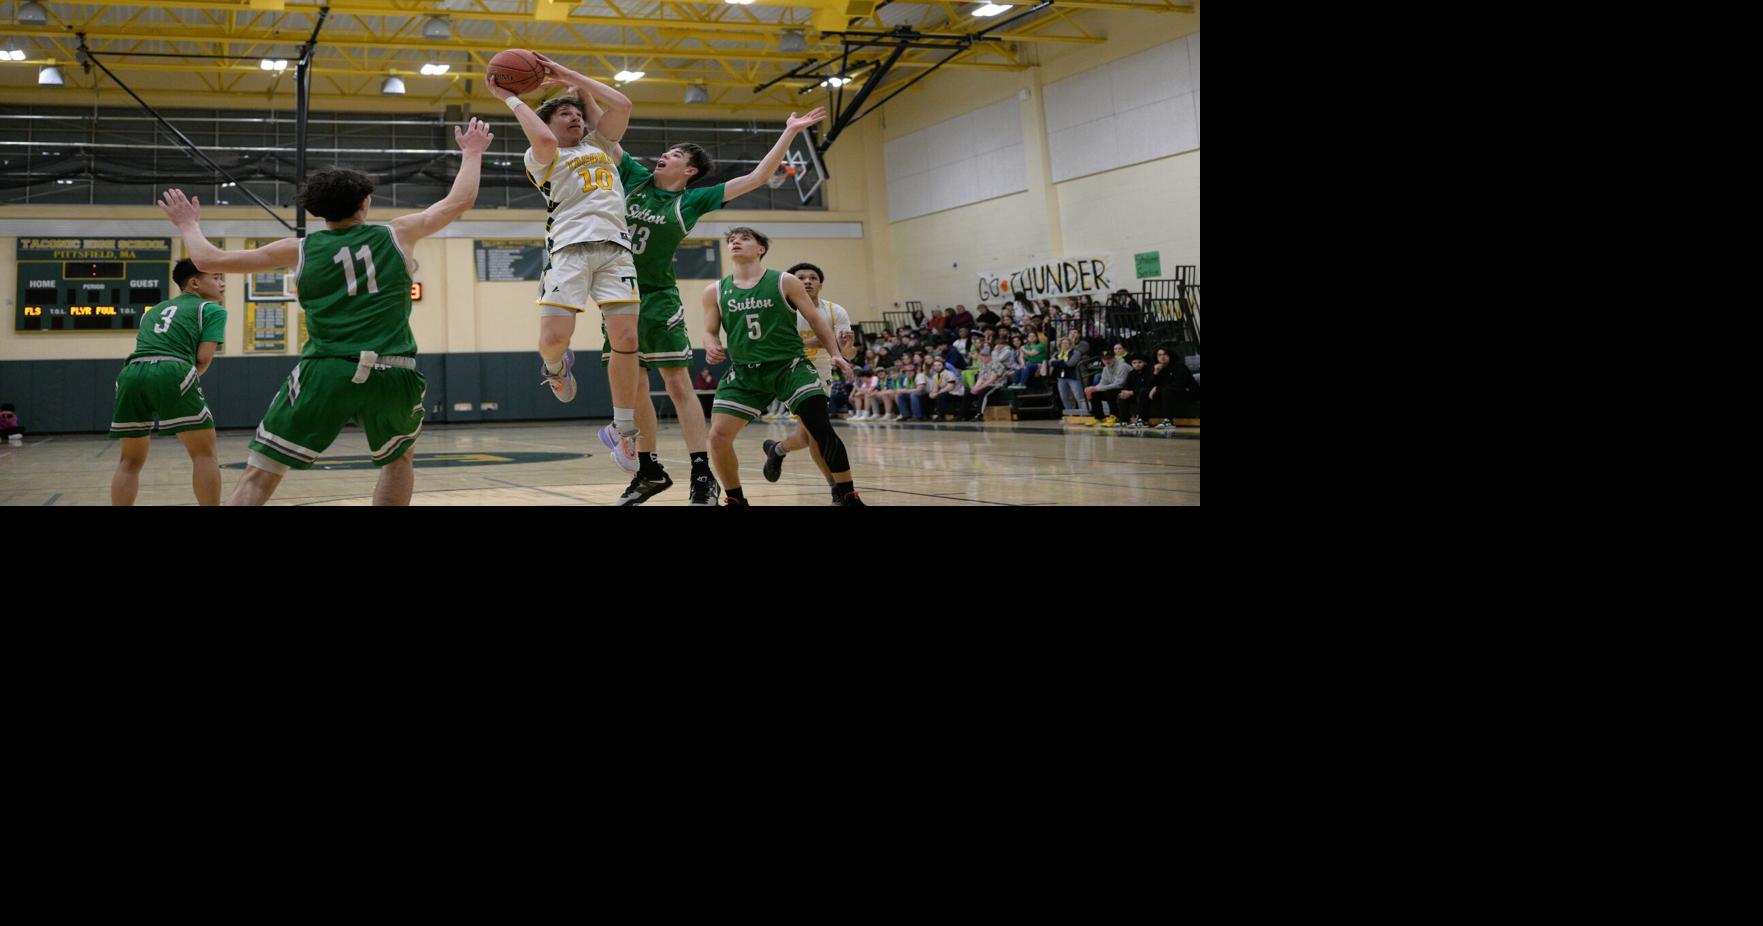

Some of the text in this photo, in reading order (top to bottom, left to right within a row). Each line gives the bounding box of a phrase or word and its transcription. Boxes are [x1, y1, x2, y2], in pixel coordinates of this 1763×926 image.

[578, 167, 613, 193] 10
[117, 239, 168, 249] SCHOOL
[627, 223, 651, 255] 13
[119, 250, 137, 259] MA
[29, 279, 159, 288] HOME GUEST
[332, 244, 379, 297] 11
[978, 259, 1110, 301] GO THUNDER
[23, 306, 42, 316] FLS
[70, 306, 92, 316] PLYR
[96, 307, 117, 316] FOUL
[727, 297, 775, 312] Sutton
[153, 305, 178, 334] 3
[745, 313, 762, 340] 5
